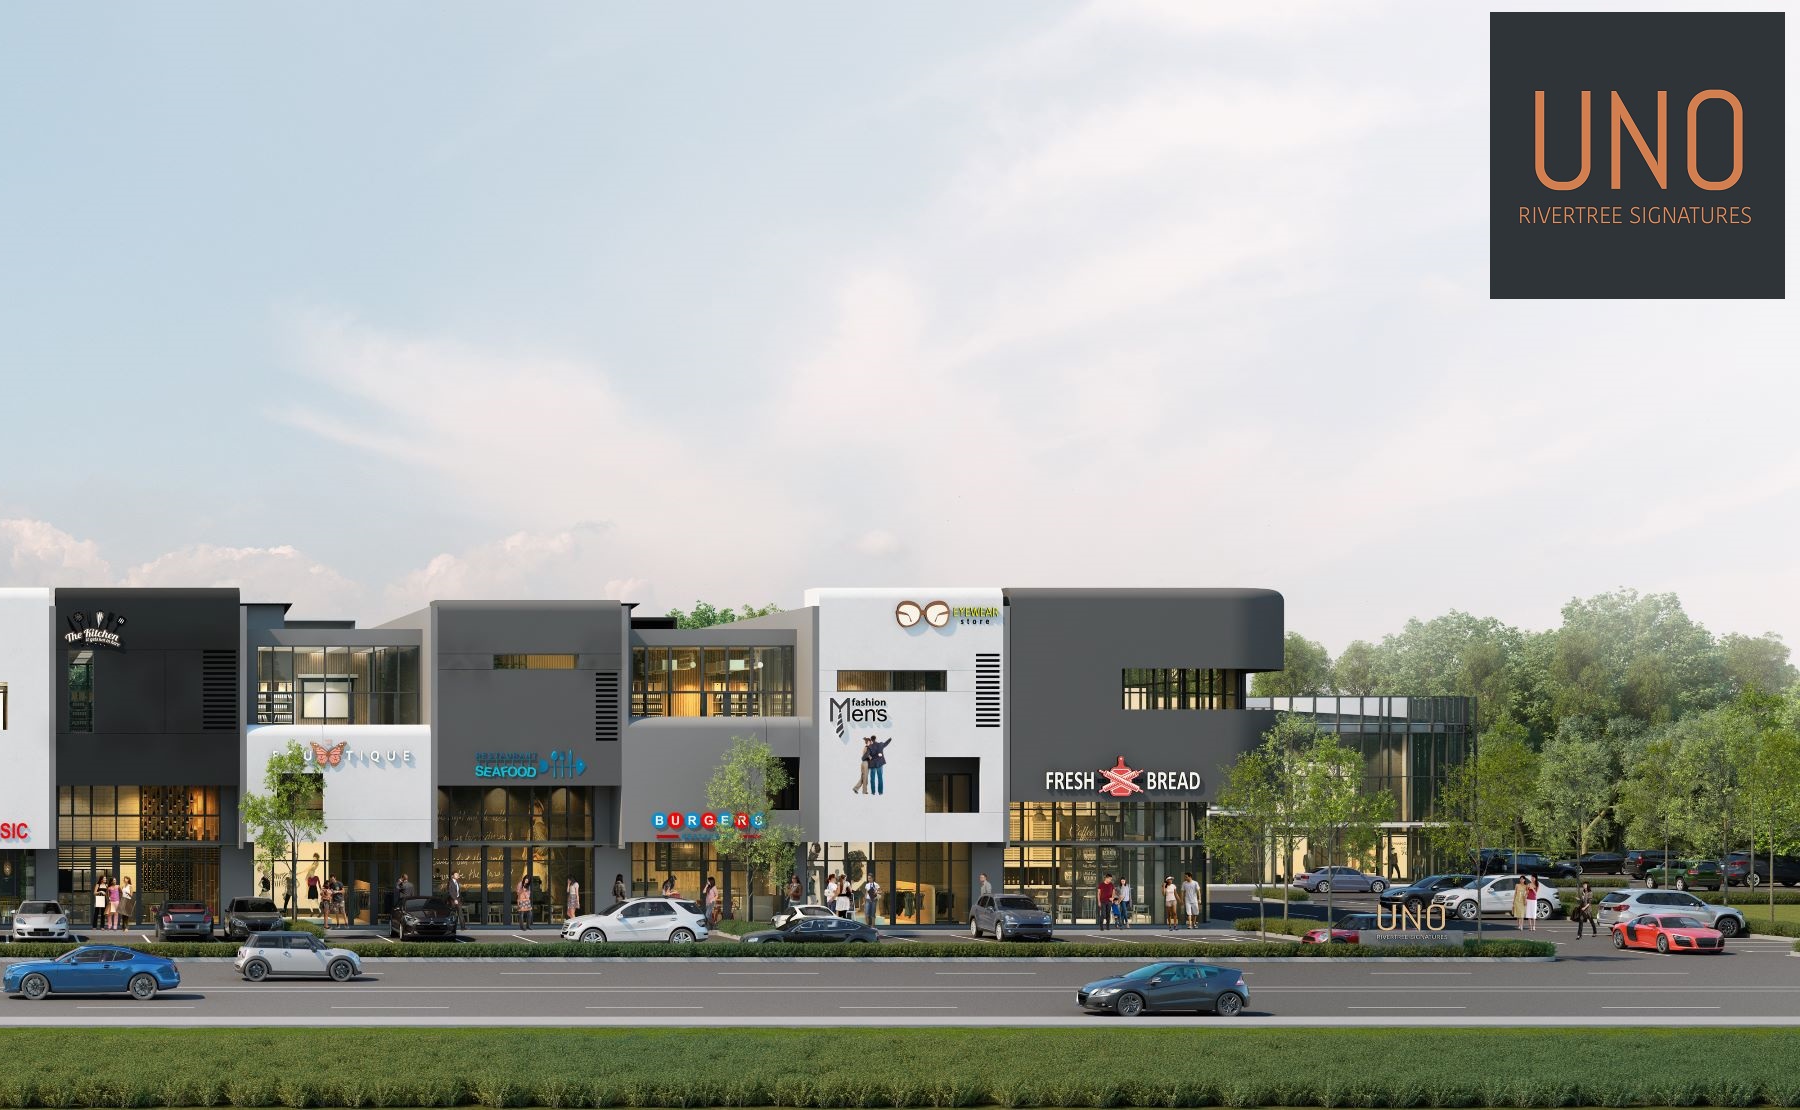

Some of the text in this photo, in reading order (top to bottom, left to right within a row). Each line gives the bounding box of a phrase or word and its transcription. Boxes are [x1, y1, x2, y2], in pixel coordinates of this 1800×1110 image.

[952, 607, 999, 618] EYEWEAR
[64, 628, 119, 643] The Kitchen
[851, 697, 887, 707] fashion
[829, 697, 888, 730] Men's
[272, 750, 411, 763] BUTIQUE
[475, 765, 537, 778] SEAFOOD
[1045, 771, 1201, 790] FRESH BREAD
[1376, 904, 1446, 932] UNO
